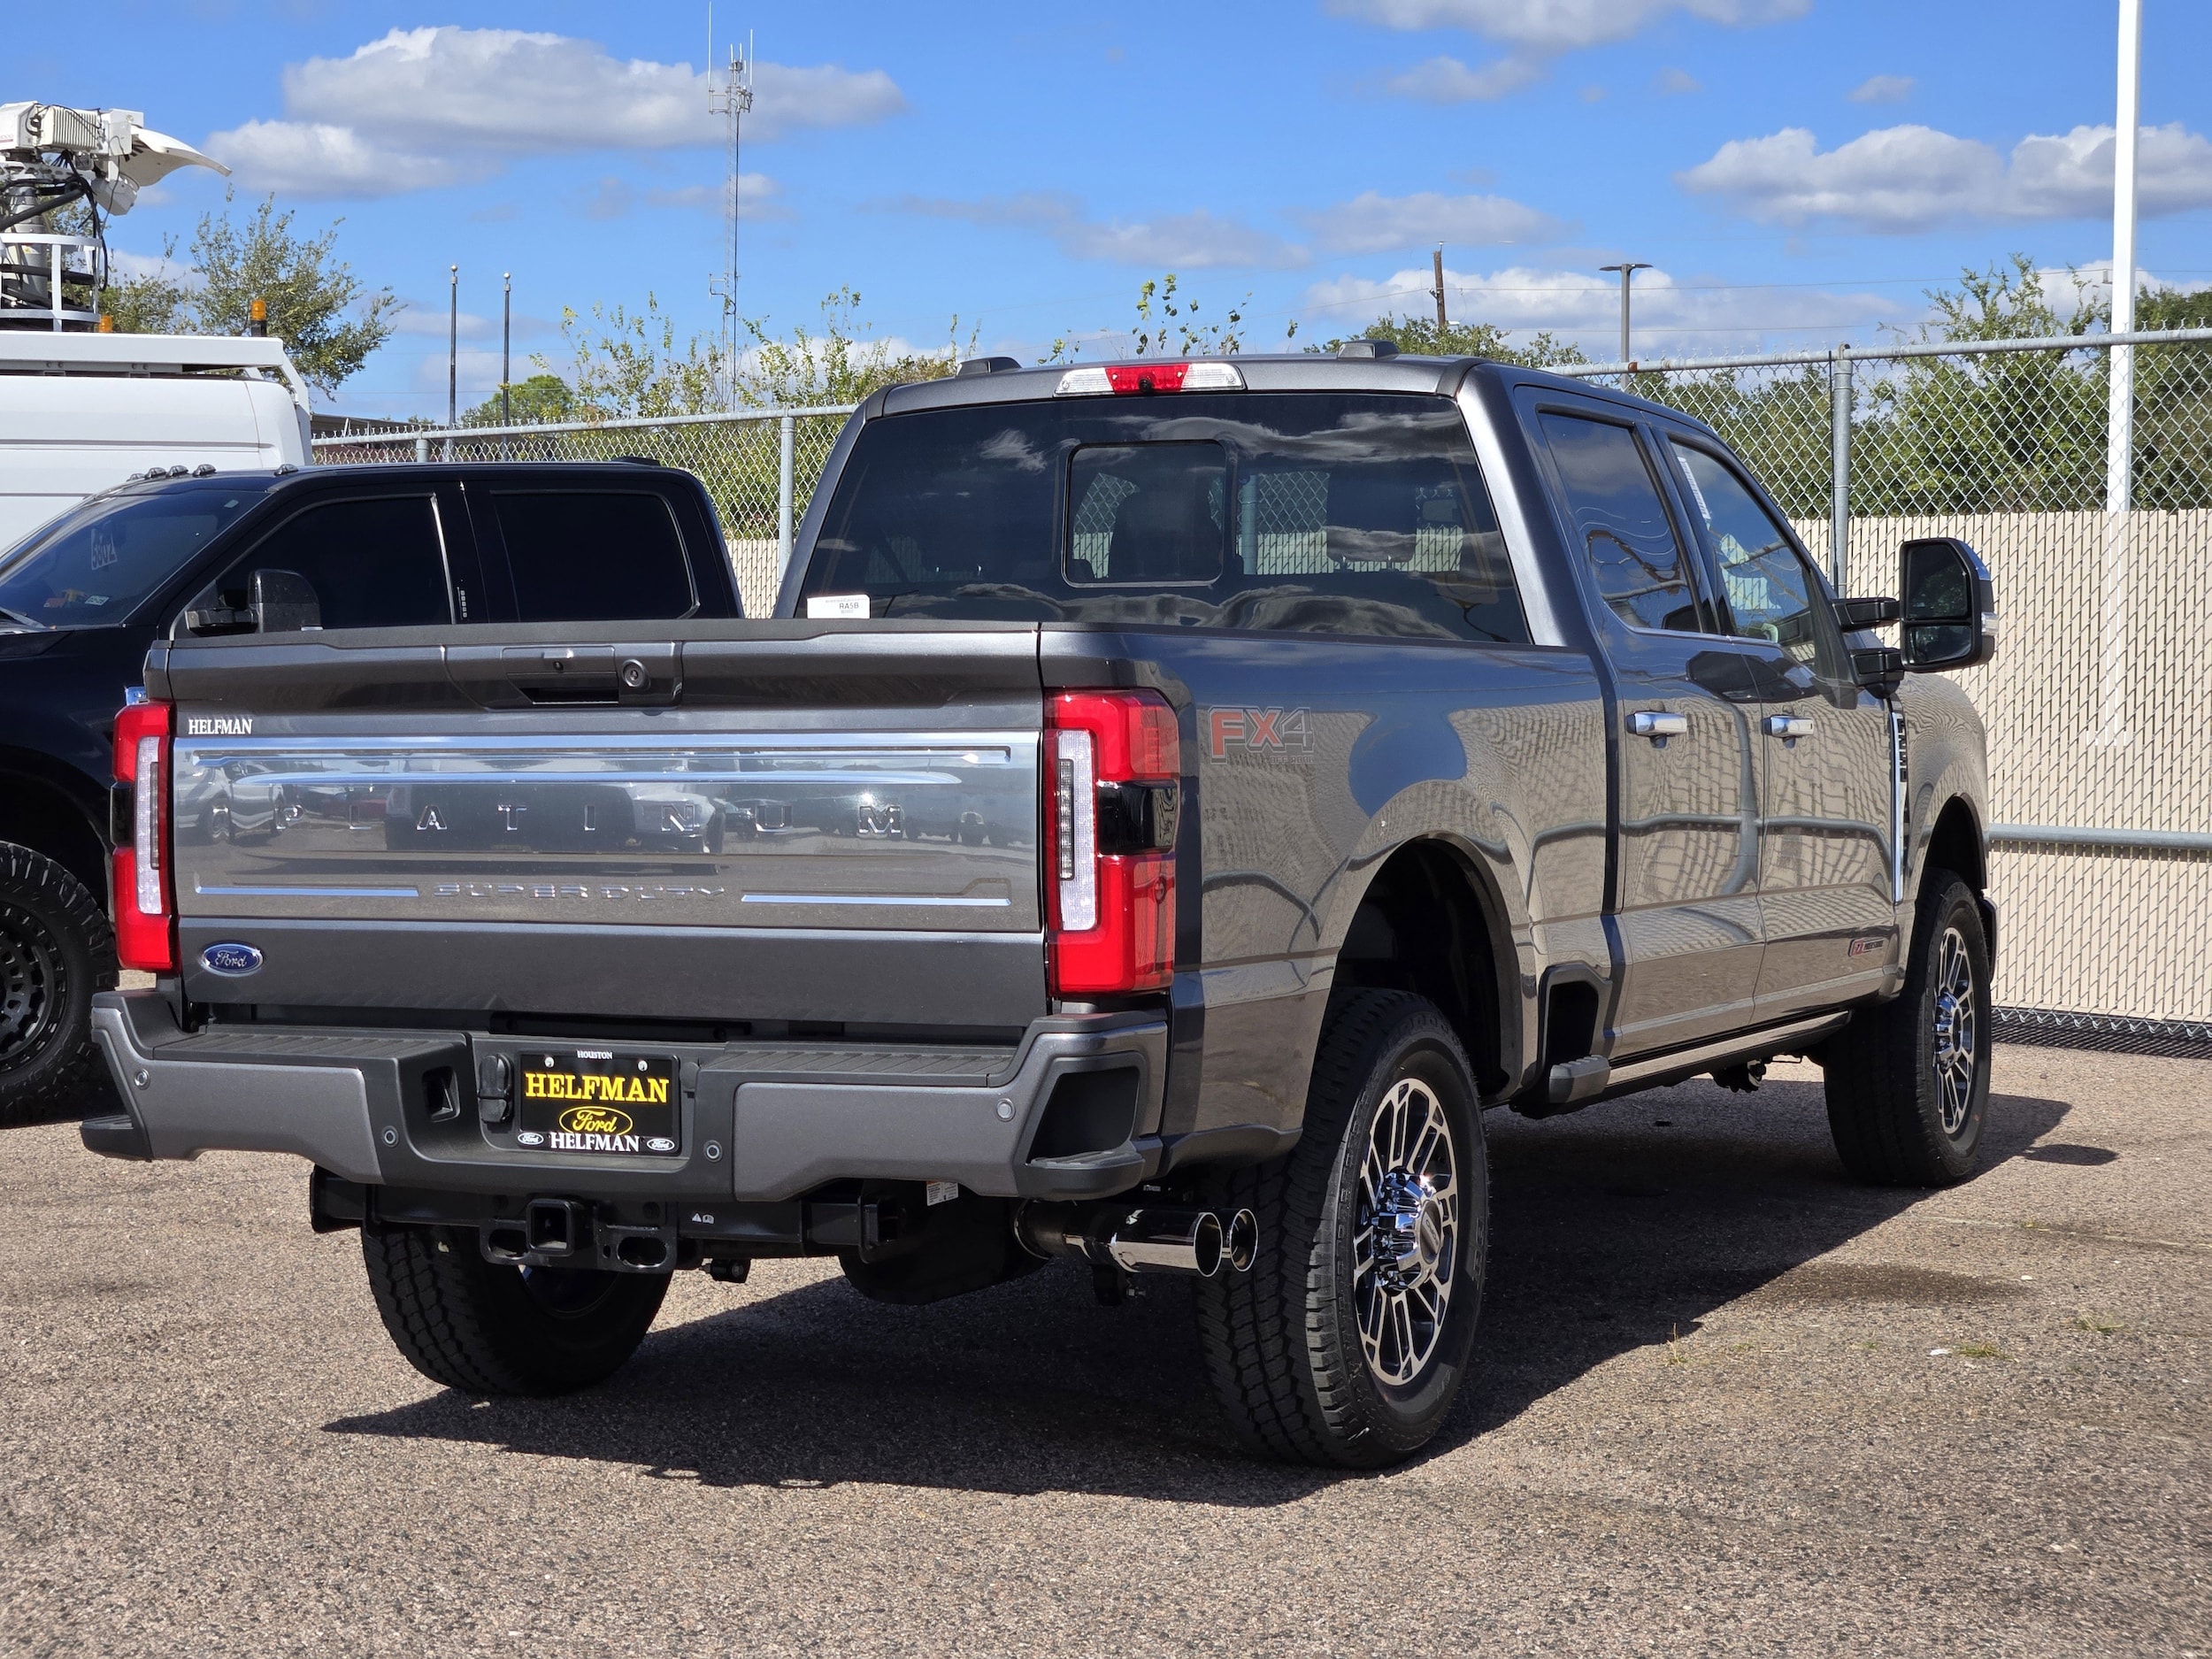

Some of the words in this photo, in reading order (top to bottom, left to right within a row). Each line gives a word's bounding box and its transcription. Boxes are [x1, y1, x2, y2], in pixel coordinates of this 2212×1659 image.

[188, 718, 253, 735] HELFMAN
[1208, 705, 1315, 764] FX4
[273, 803, 905, 834] PLATINUM
[434, 884, 589, 899] SUPER
[214, 949, 248, 967] Ford
[577, 1049, 613, 1060] HOUSTON
[525, 1071, 670, 1103] HELFMAN
[572, 1110, 618, 1133] Ford
[549, 1132, 640, 1153] HELFMAN
